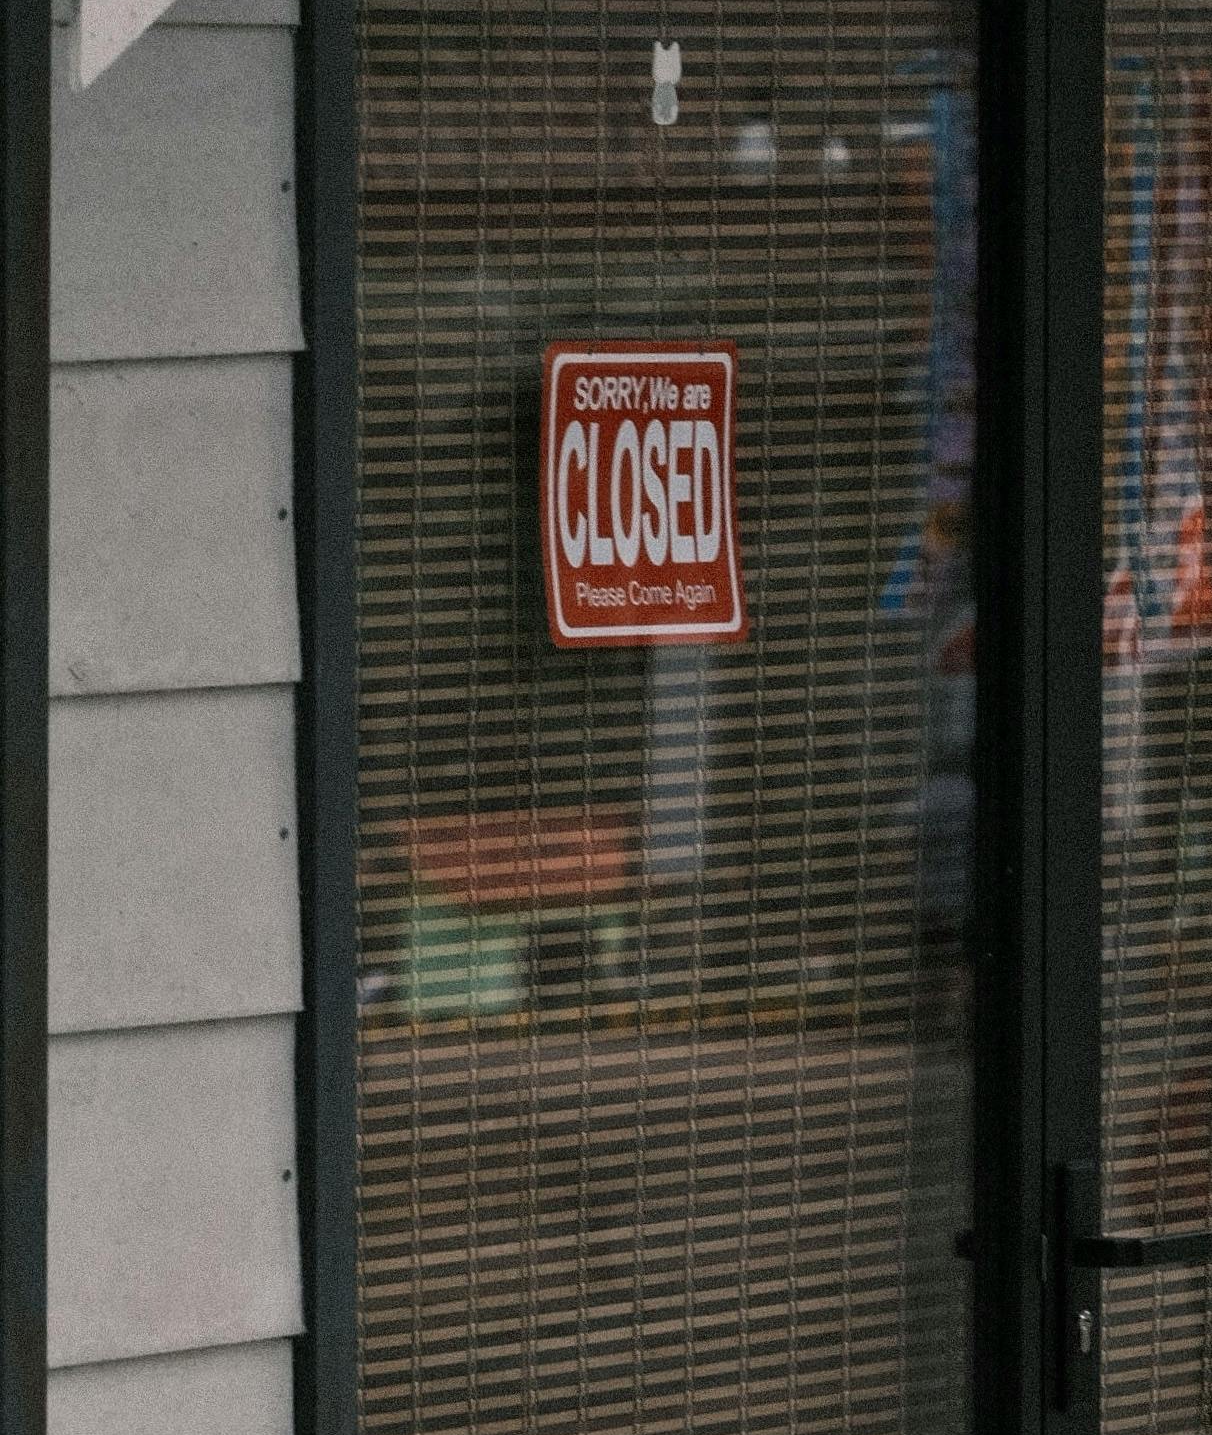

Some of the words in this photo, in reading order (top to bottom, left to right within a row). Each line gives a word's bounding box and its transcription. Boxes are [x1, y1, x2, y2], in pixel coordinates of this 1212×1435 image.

[683, 384, 711, 410] are
[558, 419, 721, 568] CLOSED
[575, 582, 626, 607] Please
[626, 580, 673, 606] Come
[675, 580, 716, 611] Again
